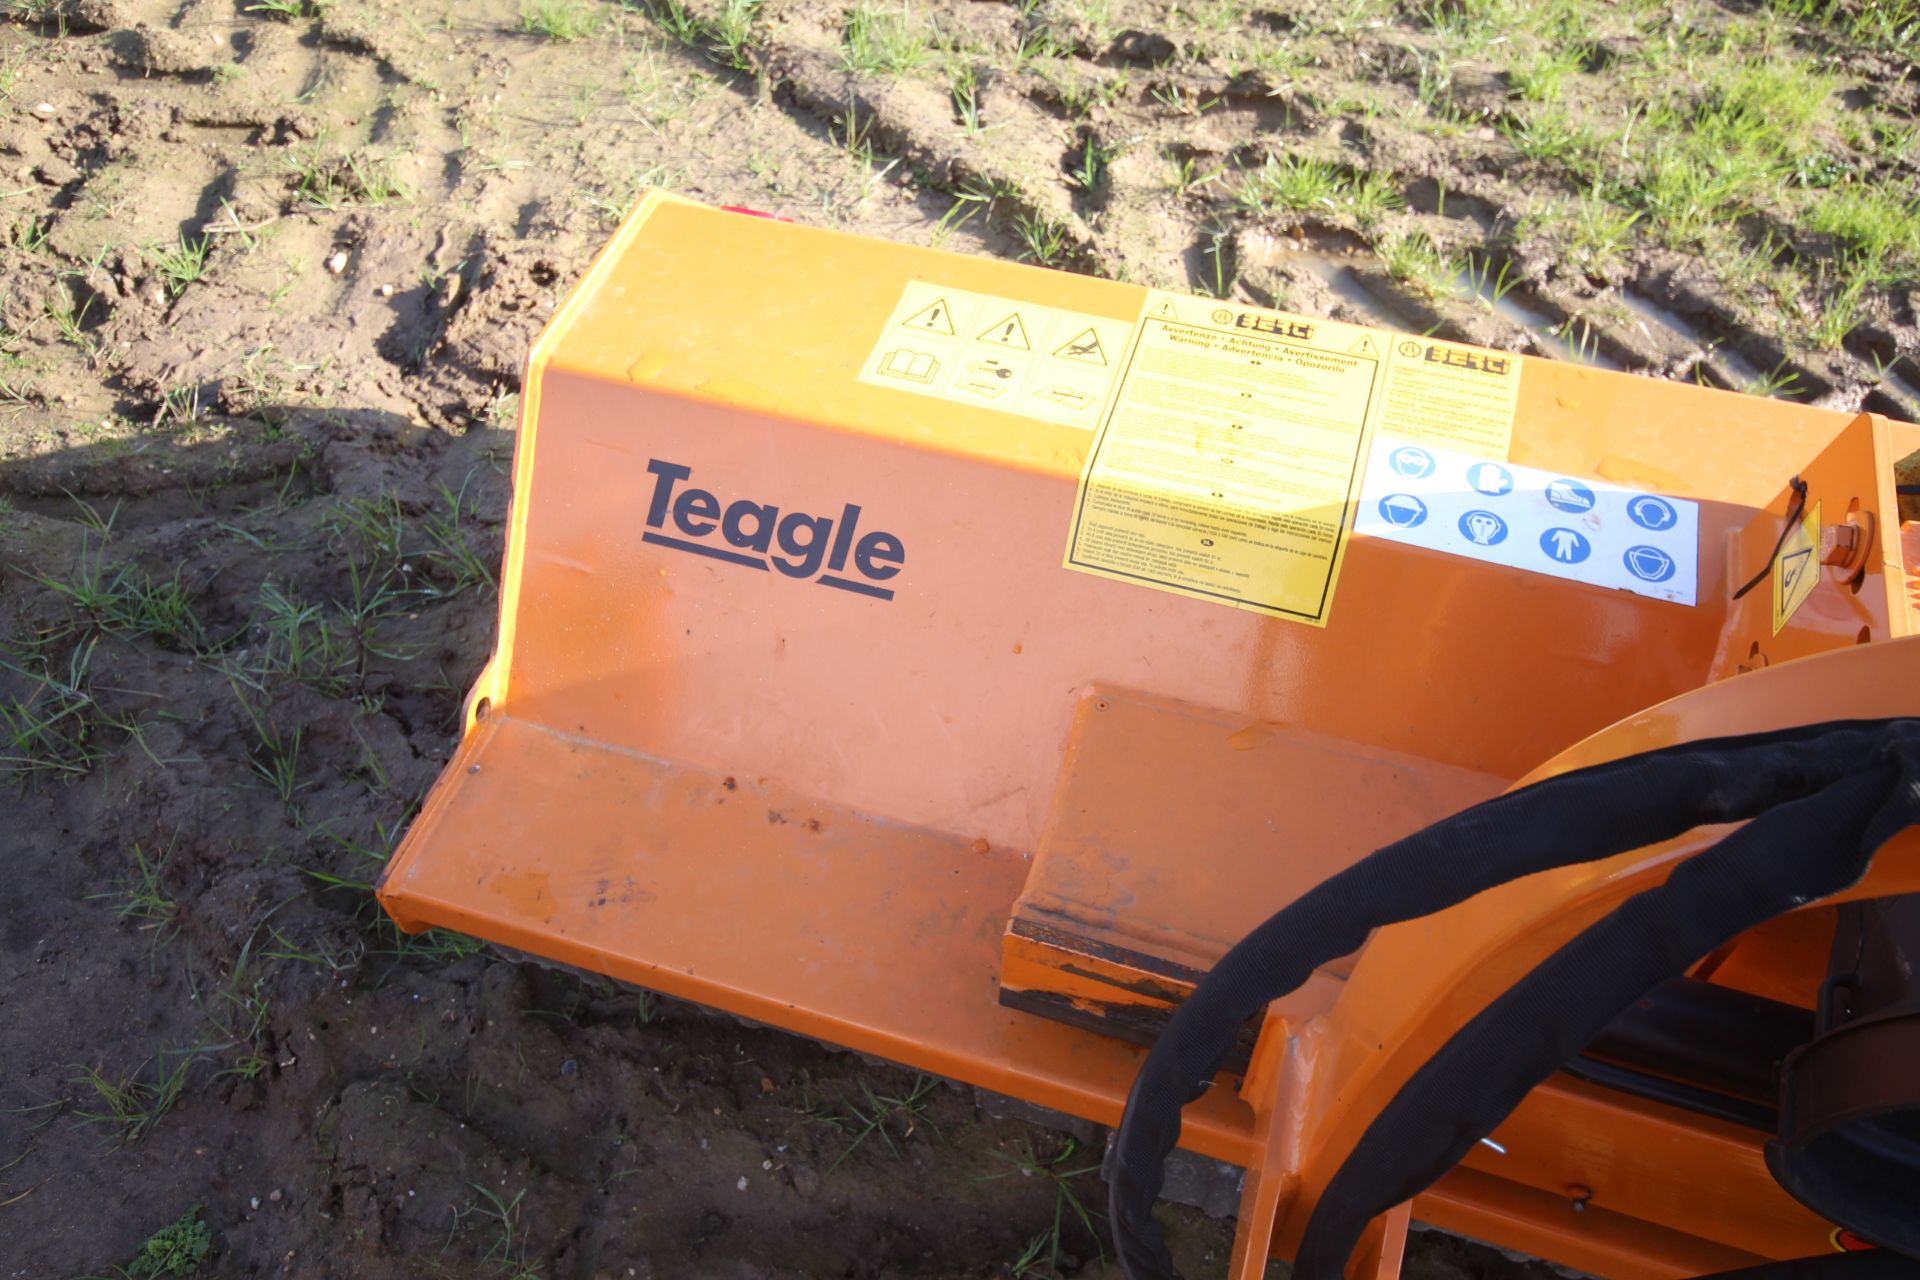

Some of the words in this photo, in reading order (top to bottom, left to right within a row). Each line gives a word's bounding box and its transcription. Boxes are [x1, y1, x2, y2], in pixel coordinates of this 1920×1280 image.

[1169, 334, 1210, 349] Warning
[1221, 344, 1283, 362] Advertencia
[1228, 337, 1271, 352] Achtung
[1283, 347, 1358, 367] Avertissement
[646, 458, 905, 580] Teagle
